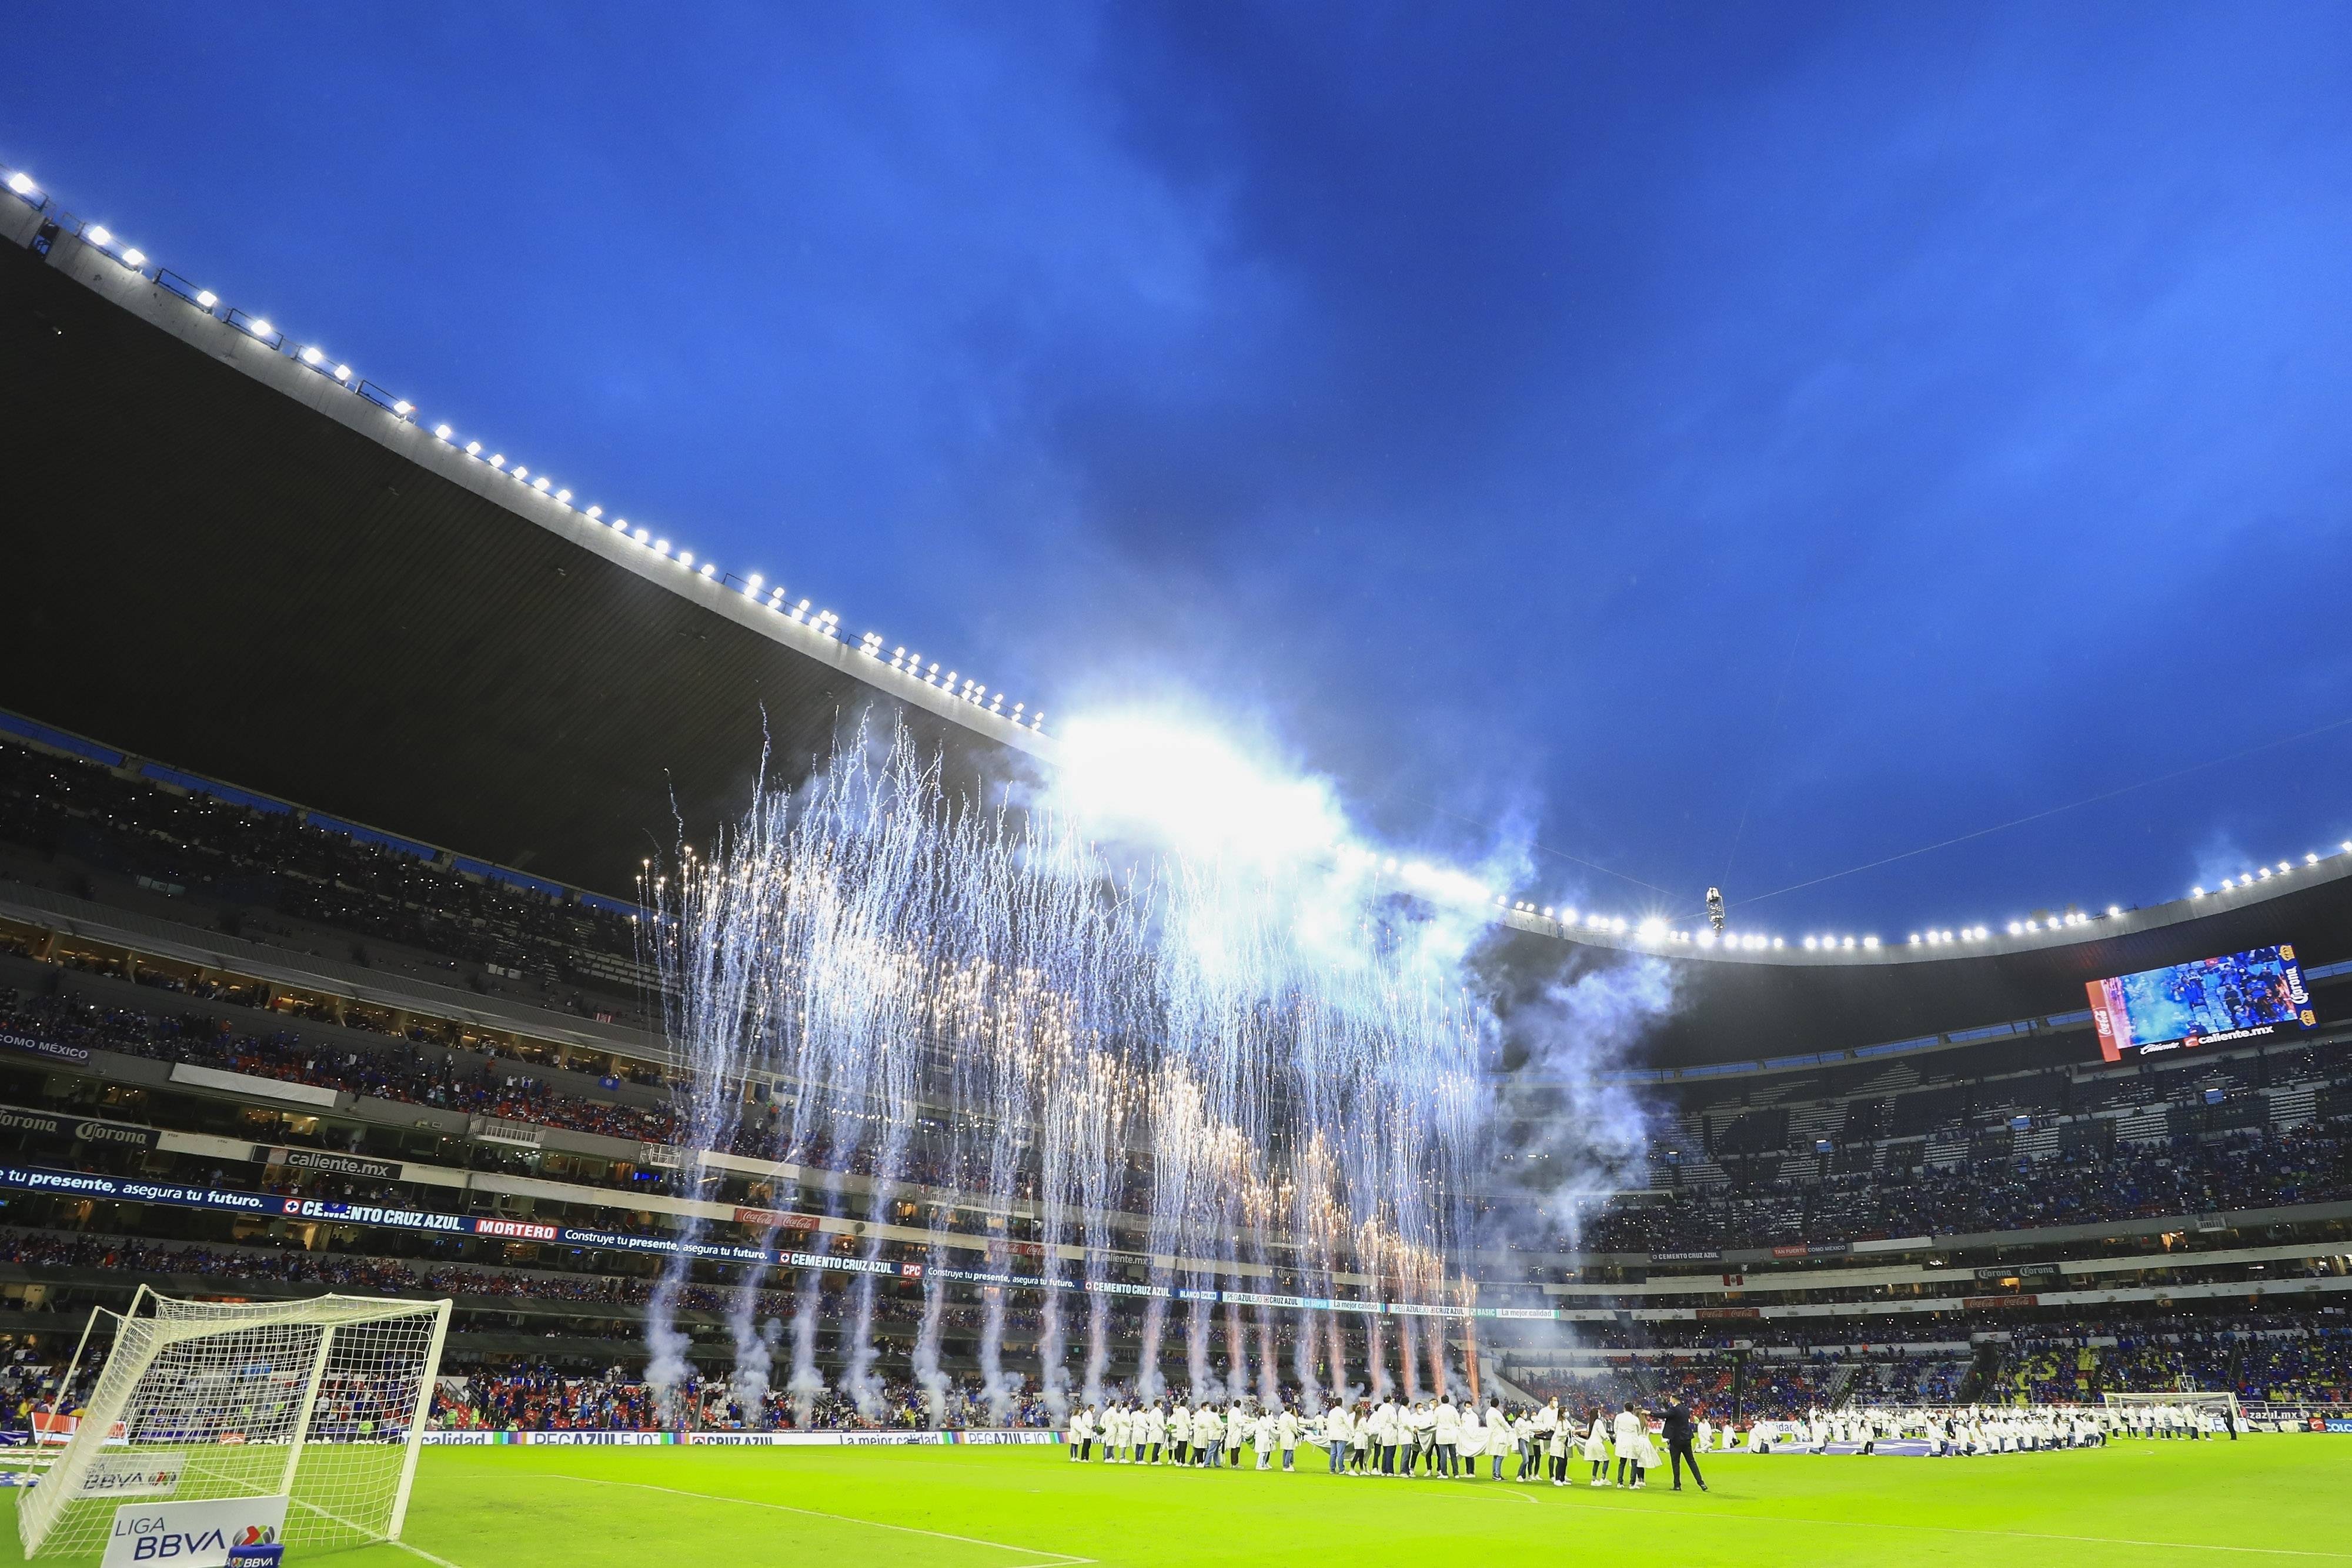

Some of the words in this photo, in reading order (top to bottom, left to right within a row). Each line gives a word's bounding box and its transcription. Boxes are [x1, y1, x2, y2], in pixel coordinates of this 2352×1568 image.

[2286, 966, 2309, 1005] Corona
[2198, 1025, 2274, 1045] caliente.mx
[38, 1042, 88, 1059] MÉXICO
[75, 1122, 147, 1145] Corona
[288, 1152, 389, 1176] caliente.mx
[9, 1169, 25, 1182] tu
[29, 1172, 117, 1193] presente,
[122, 1183, 182, 1201] asegura
[186, 1189, 203, 1201] tu
[207, 1191, 263, 1208] futuro.
[302, 1201, 383, 1222] CEENTO
[383, 1208, 427, 1227] CRUZ
[424, 1213, 465, 1231] AZUL.
[742, 1211, 773, 1224] Coca-Cola
[783, 1216, 812, 1229] Coca-Cola
[478, 1220, 554, 1239] MORTERO
[564, 1229, 614, 1244] Construye
[617, 1236, 627, 1245] tu
[629, 1238, 680, 1252] presente,
[683, 1243, 719, 1255] asegura
[720, 1246, 731, 1256] tu
[733, 1246, 767, 1260] futuro.
[1027, 1245, 1050, 1256] Coca-Co
[791, 1253, 841, 1270] CEMENTO
[842, 1256, 868, 1271] CRUZ
[868, 1261, 895, 1274] AZUL.
[1101, 1254, 1148, 1266] caliente.mx
[903, 1264, 921, 1276] CPC
[928, 1266, 963, 1279] Construye
[973, 1272, 1010, 1284] presente,
[1013, 1276, 1038, 1286] asegura
[1049, 1278, 1075, 1288] futuro.
[1979, 1269, 2012, 1279] Corona
[2020, 1266, 2054, 1276] Corona
[1093, 1281, 1131, 1294] CEMENTO
[1132, 1283, 1151, 1295] CRUZ
[1180, 1290, 1200, 1299] BLANCO
[1269, 1295, 1284, 1304] CRUZ
[1284, 1297, 1298, 1305] AZUL
[1341, 1302, 1357, 1310] mejor
[1511, 1310, 1528, 1318] mejor
[1529, 1309, 1552, 1318] calidad
[83, 1472, 143, 1490] BBVA
[115, 1517, 165, 1536] LIGA
[133, 1528, 225, 1561] BBVA
[243, 1557, 273, 1567] BBVA
